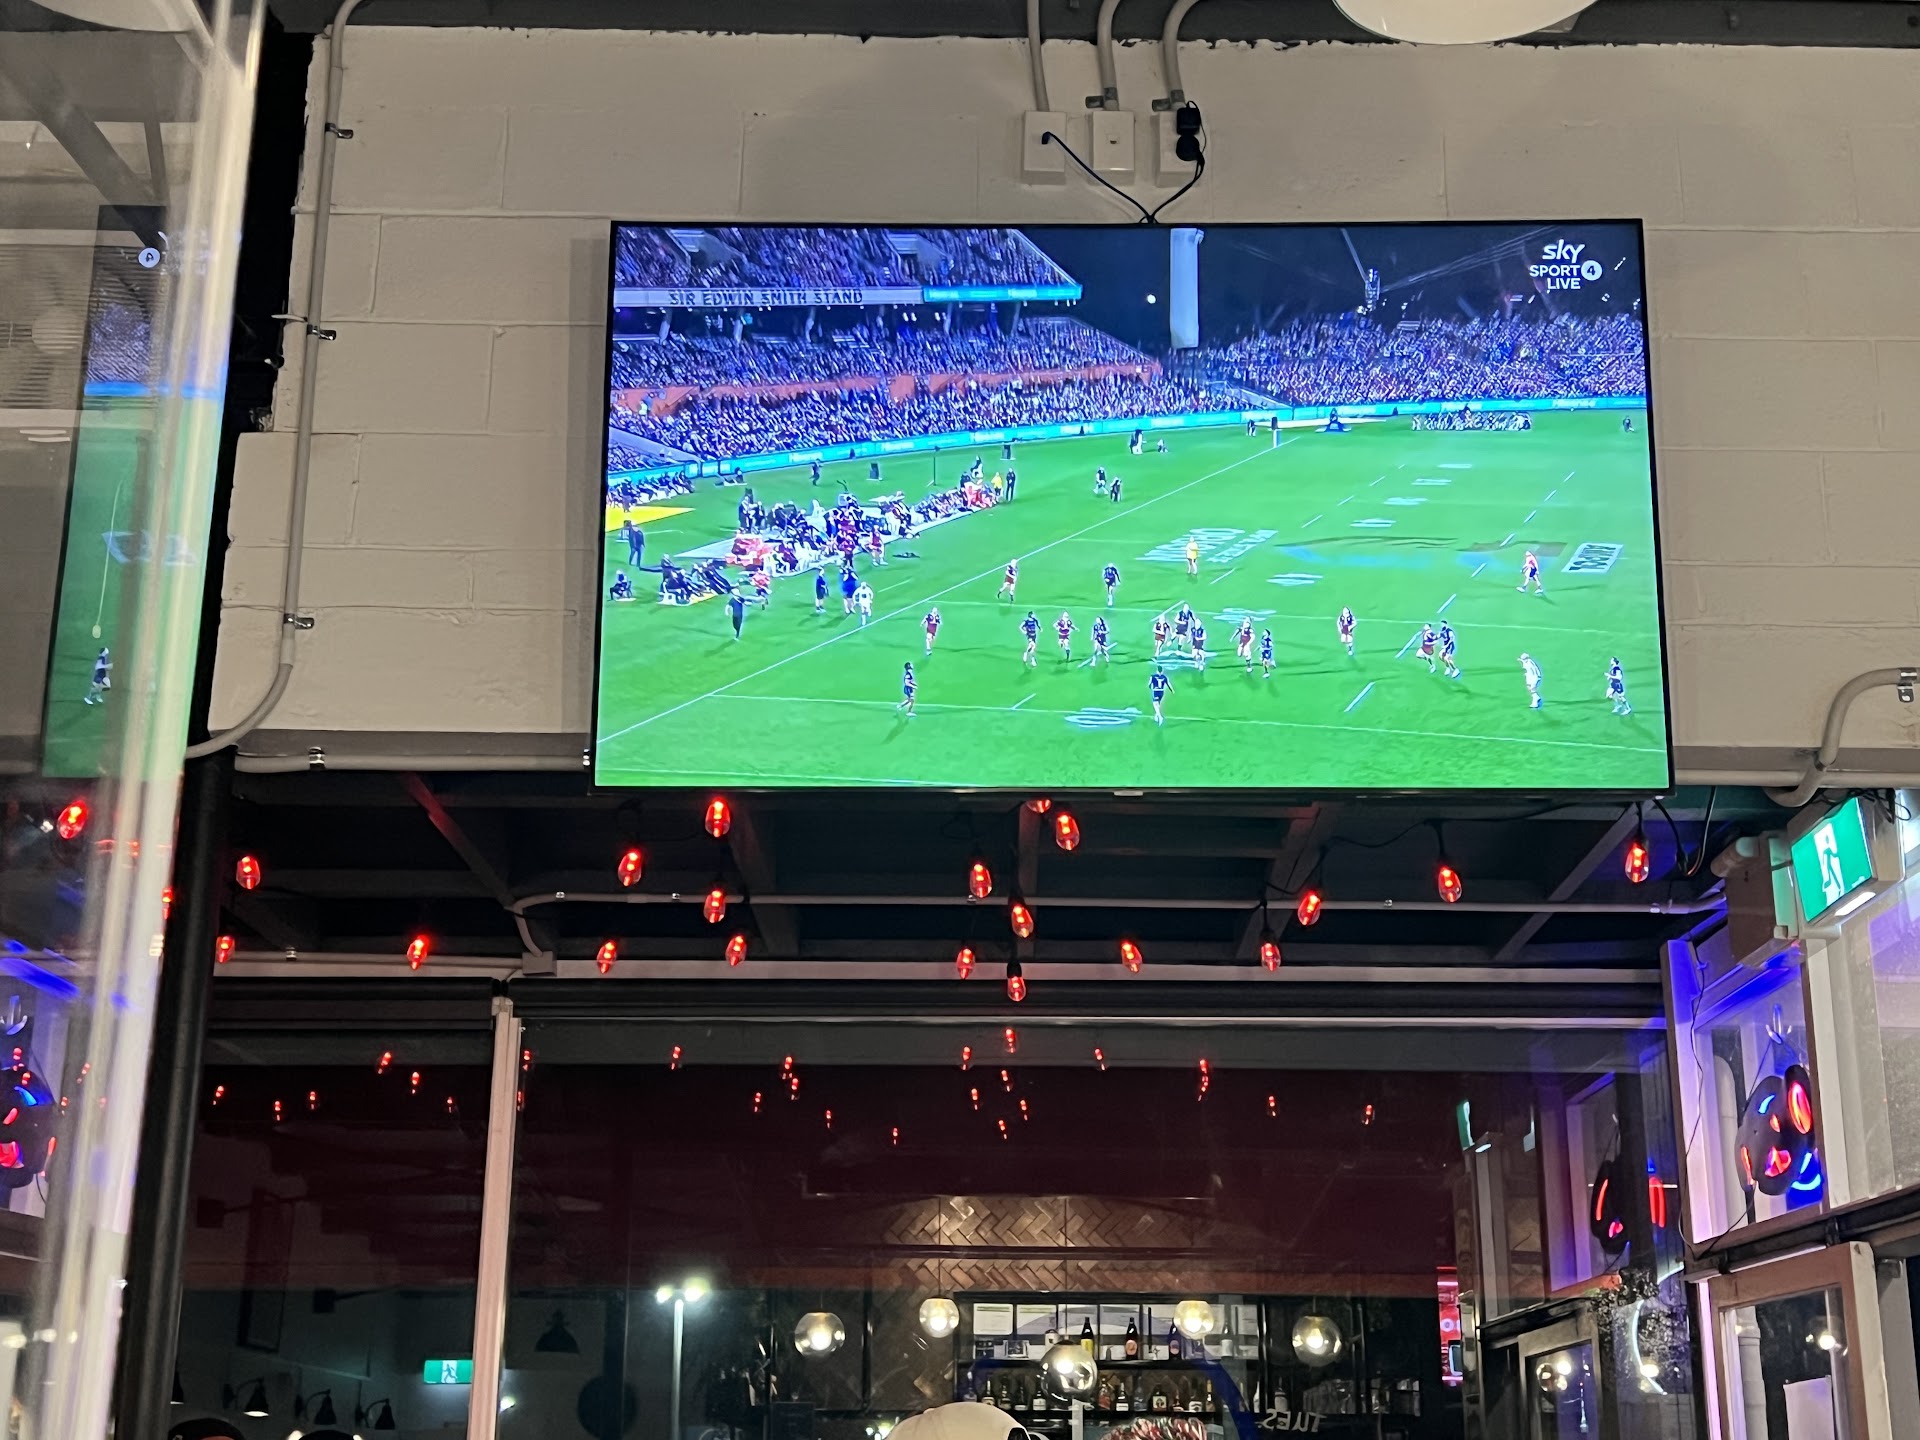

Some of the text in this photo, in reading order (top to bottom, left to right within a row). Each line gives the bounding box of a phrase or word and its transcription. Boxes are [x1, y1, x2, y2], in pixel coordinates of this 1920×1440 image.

[1542, 239, 1585, 263] sky
[1529, 265, 1580, 277] SPORT
[1547, 278, 1580, 290] LIVE
[669, 289, 863, 305] SIR EDWIN SMITH STAND
